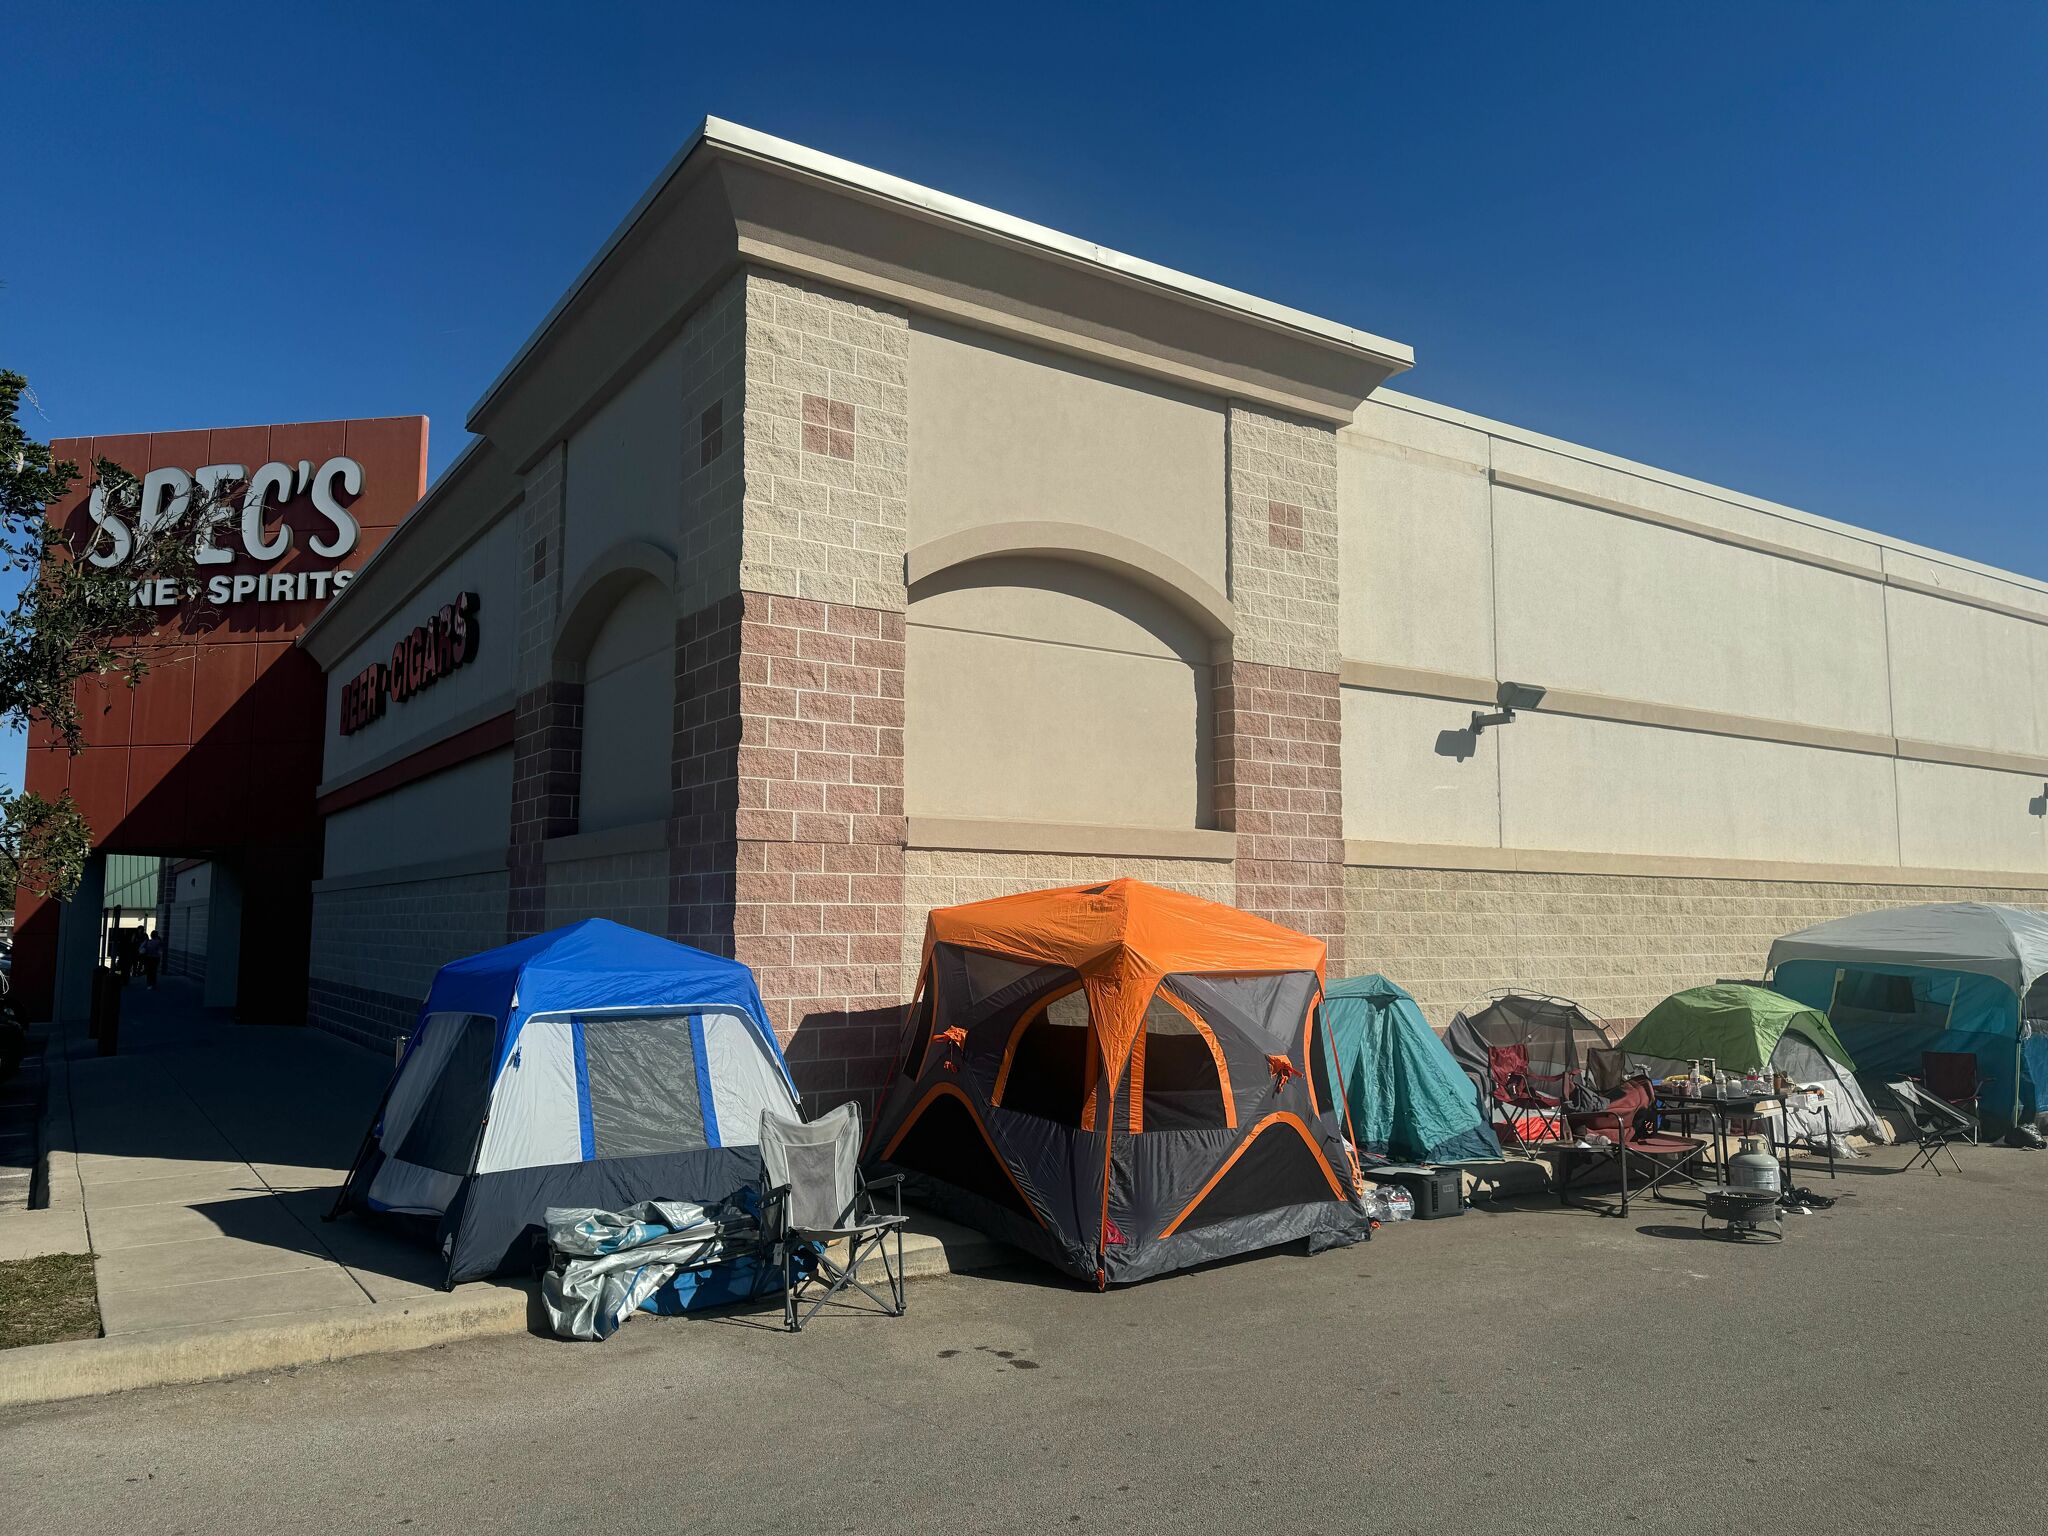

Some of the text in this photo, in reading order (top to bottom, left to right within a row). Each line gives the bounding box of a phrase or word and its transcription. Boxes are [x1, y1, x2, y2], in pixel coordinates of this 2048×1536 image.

[88, 456, 364, 568] SPEC'S
[208, 570, 355, 605] SPIRITS
[340, 592, 470, 736] BEER CIGARS
